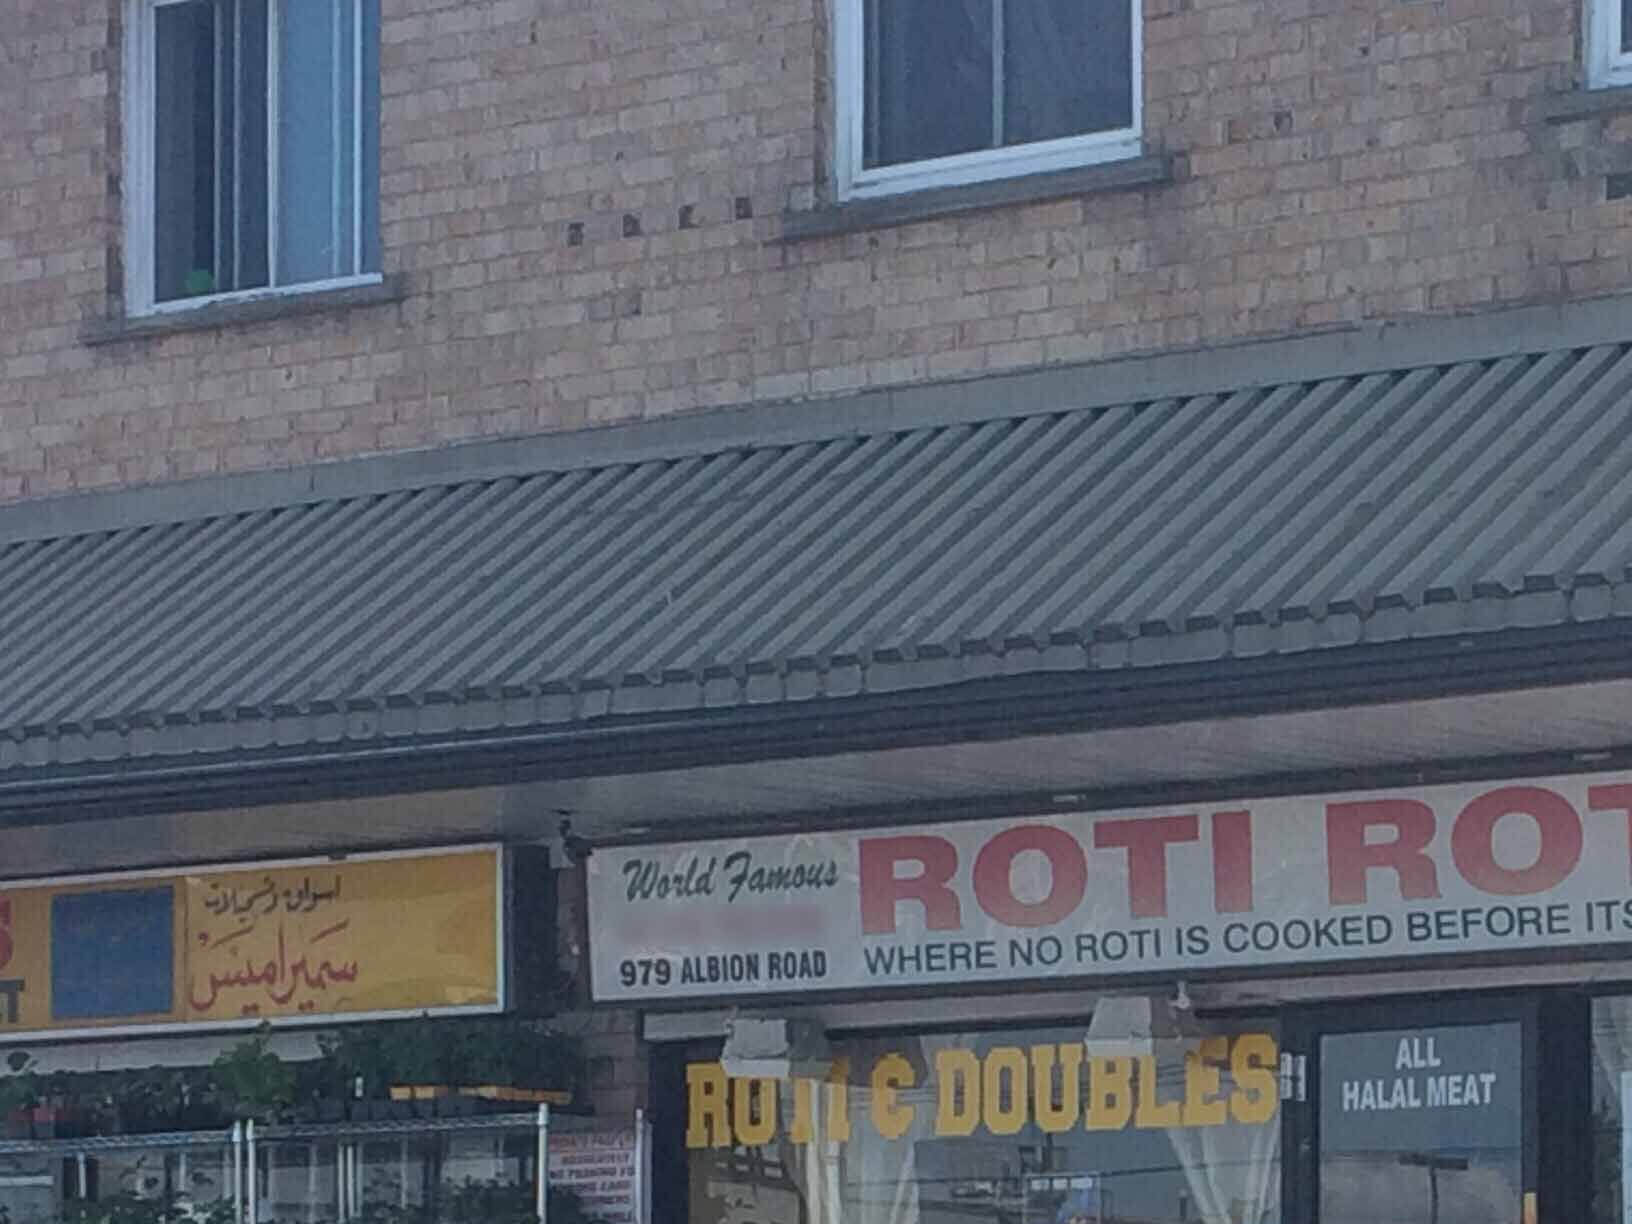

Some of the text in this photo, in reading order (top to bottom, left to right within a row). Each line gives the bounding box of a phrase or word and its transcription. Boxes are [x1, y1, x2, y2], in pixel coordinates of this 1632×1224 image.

[623, 851, 839, 903] World Famous
[858, 810, 1254, 937] ROTI
[863, 940, 998, 975] WHERE
[1008, 934, 1063, 967] NO
[1075, 928, 1161, 963] ROTI
[1176, 924, 1210, 956] IS
[1222, 914, 1393, 954] COOKED
[1406, 903, 1572, 942] BEFORE
[620, 949, 827, 987] 979 ALBION ROAD
[1395, 1036, 1442, 1070] ALL
[935, 1033, 1278, 1137] DOUBLES
[1342, 1073, 1497, 1111] HALAL MEAT
